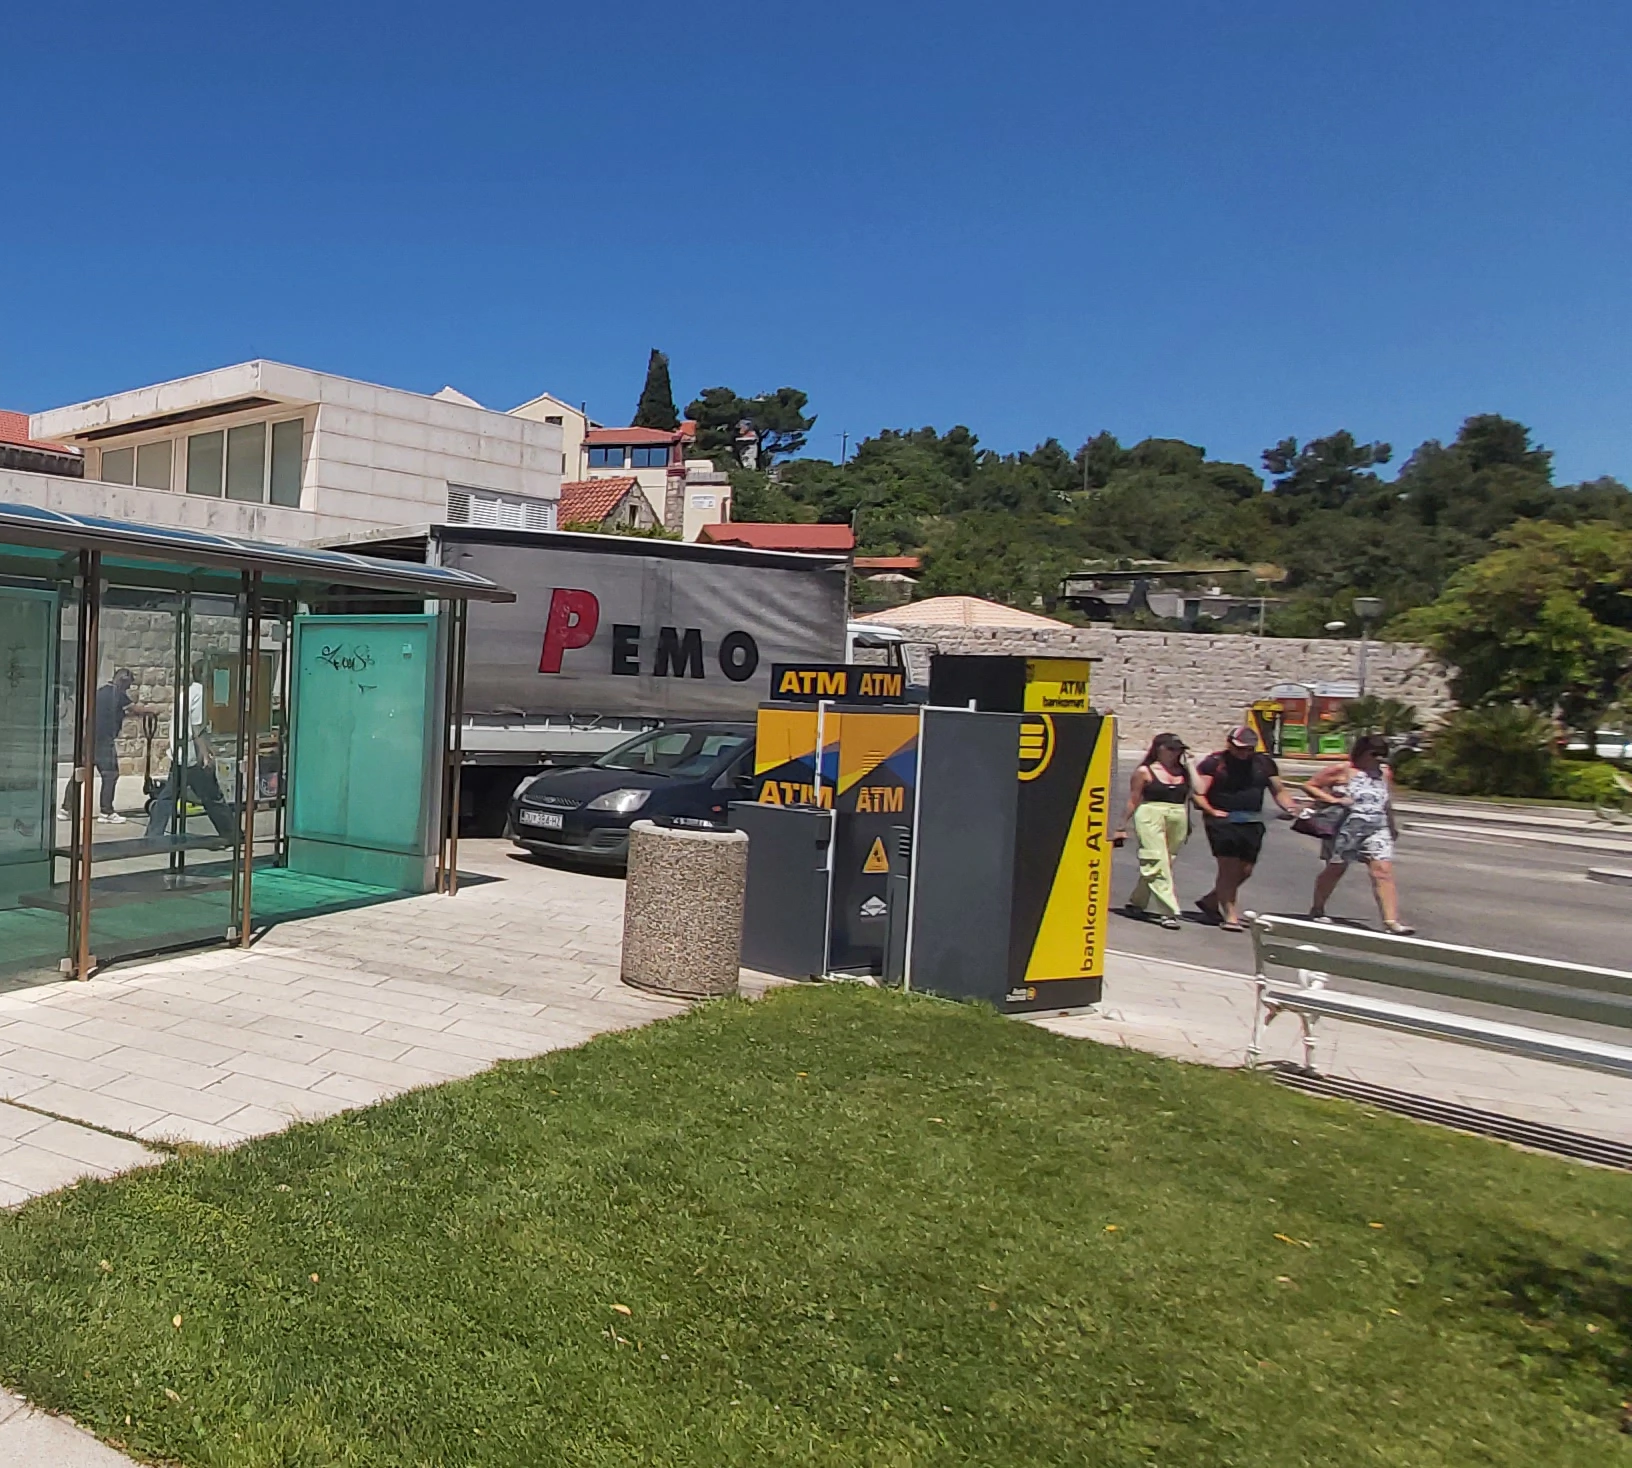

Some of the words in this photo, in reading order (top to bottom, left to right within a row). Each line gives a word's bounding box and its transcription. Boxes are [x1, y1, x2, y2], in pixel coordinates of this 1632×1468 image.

[538, 588, 759, 682] PEMO
[779, 671, 847, 695] ATM
[859, 673, 902, 696] ATM
[1059, 681, 1086, 694] ATM
[1042, 696, 1085, 708] bankomat
[758, 780, 833, 809] ATM
[856, 787, 905, 812] ATM
[1086, 787, 1105, 852] ATM
[1080, 859, 1100, 971] bankomat
